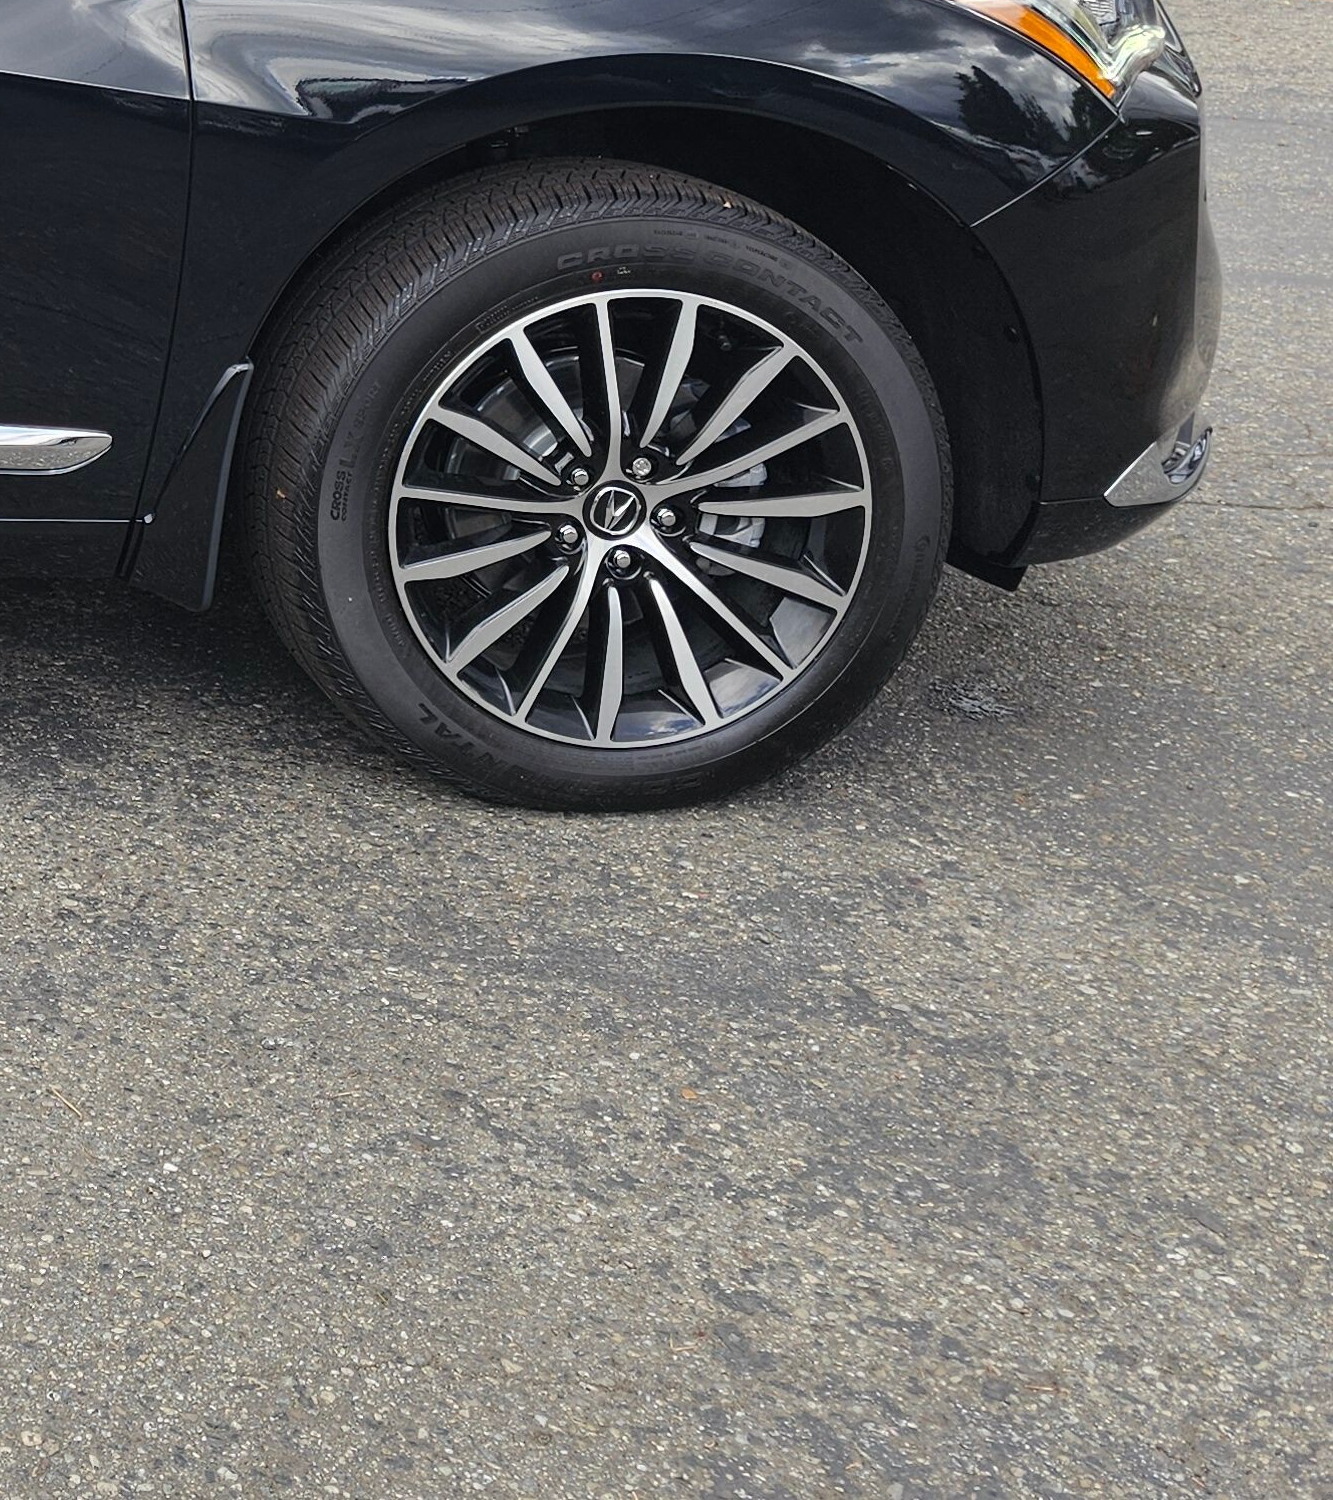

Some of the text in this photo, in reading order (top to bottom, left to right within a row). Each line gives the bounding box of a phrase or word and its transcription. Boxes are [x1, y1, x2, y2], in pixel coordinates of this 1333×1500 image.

[556, 243, 699, 270] CROSS
[703, 249, 864, 345] CONTACT
[338, 430, 365, 469] LX
[329, 469, 347, 521] CROSS
